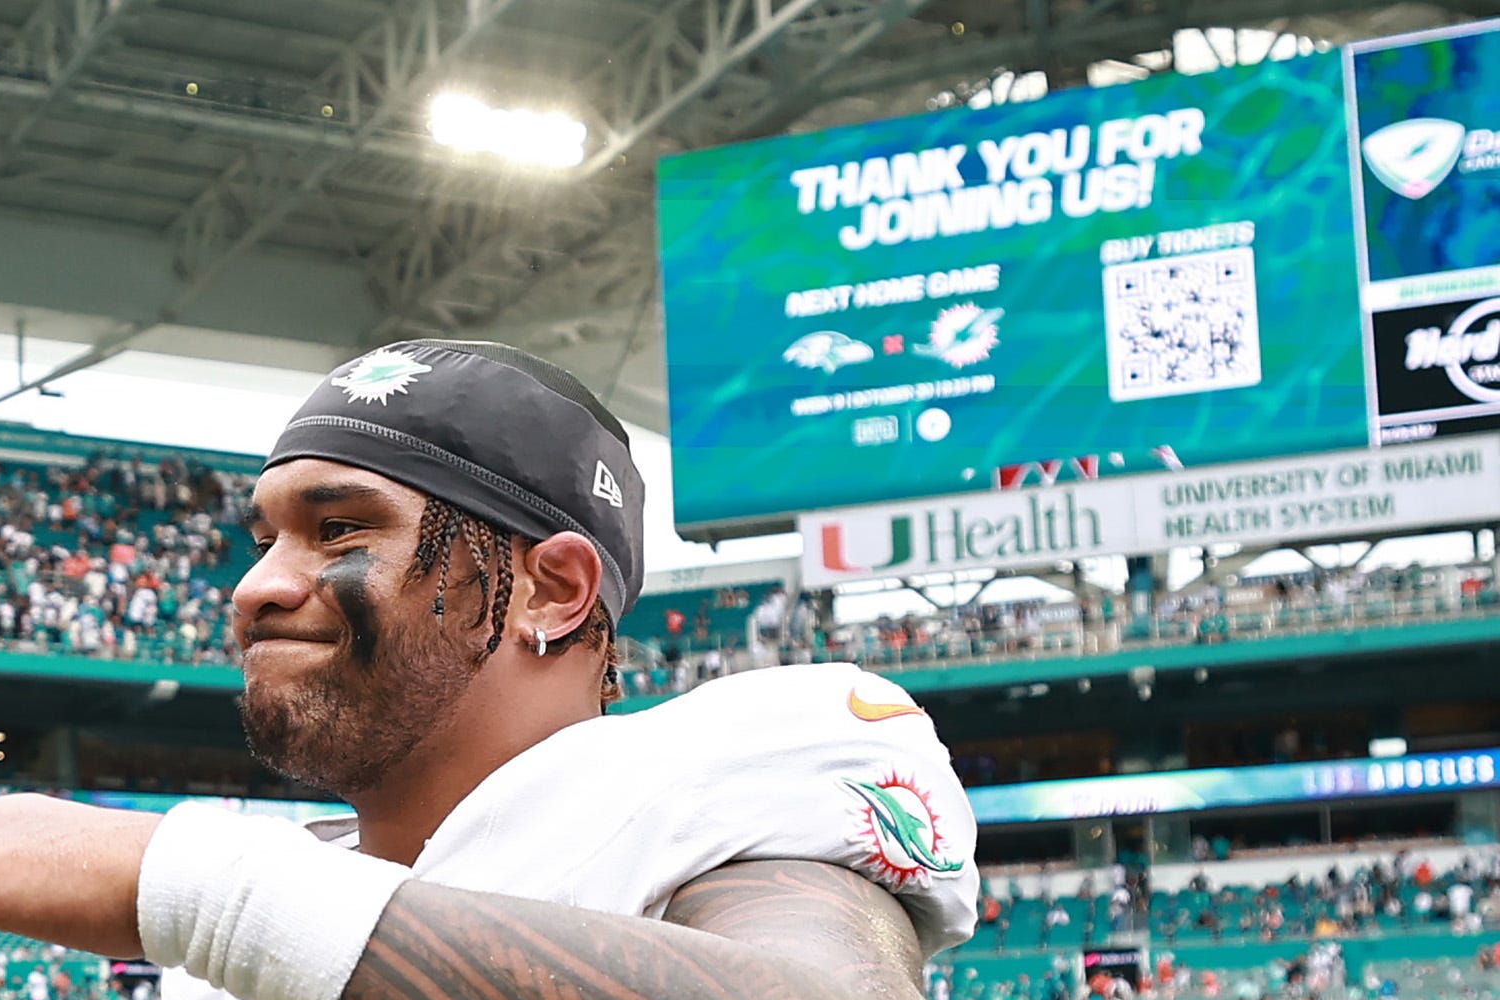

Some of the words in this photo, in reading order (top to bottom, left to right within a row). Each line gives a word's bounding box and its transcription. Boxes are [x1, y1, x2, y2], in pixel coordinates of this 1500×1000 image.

[790, 144, 968, 214] THANK
[977, 125, 1091, 184] YOU
[1096, 107, 1206, 166] FOR
[838, 178, 1053, 250] JOINING
[1060, 161, 1157, 217] US!
[1101, 237, 1153, 264] BUY
[1158, 221, 1255, 254] TICKETS
[785, 285, 852, 318] NEXT
[853, 273, 926, 309] HOME
[926, 263, 1001, 299] GAME
[1160, 465, 1329, 507] UNIVERSITY
[1337, 462, 1371, 489] OF
[1383, 448, 1484, 482] MIAMI
[1164, 505, 1272, 538] HEALTH
[1280, 493, 1396, 528] SYSTEM
